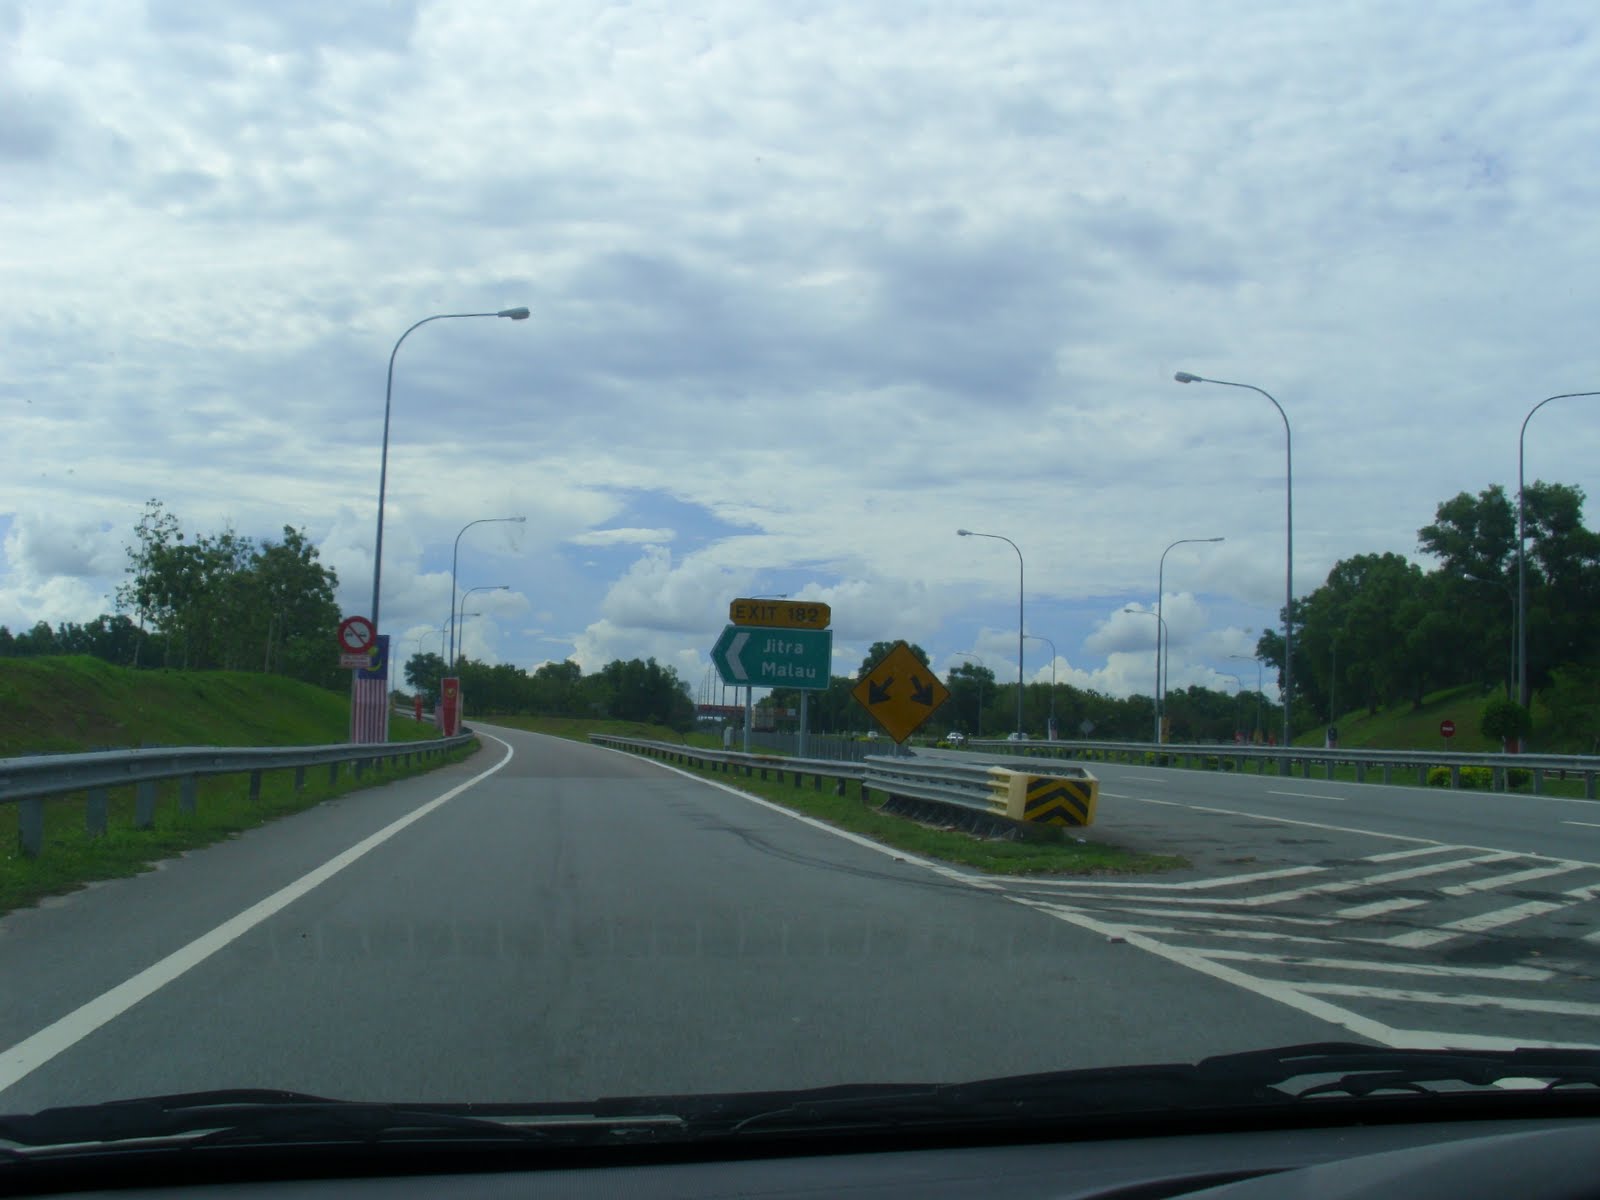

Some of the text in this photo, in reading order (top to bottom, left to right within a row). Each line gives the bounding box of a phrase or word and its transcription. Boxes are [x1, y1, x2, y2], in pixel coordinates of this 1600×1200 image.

[735, 604, 819, 623] EXIT 182
[763, 638, 804, 655] Jitra
[761, 661, 816, 679] Malau
